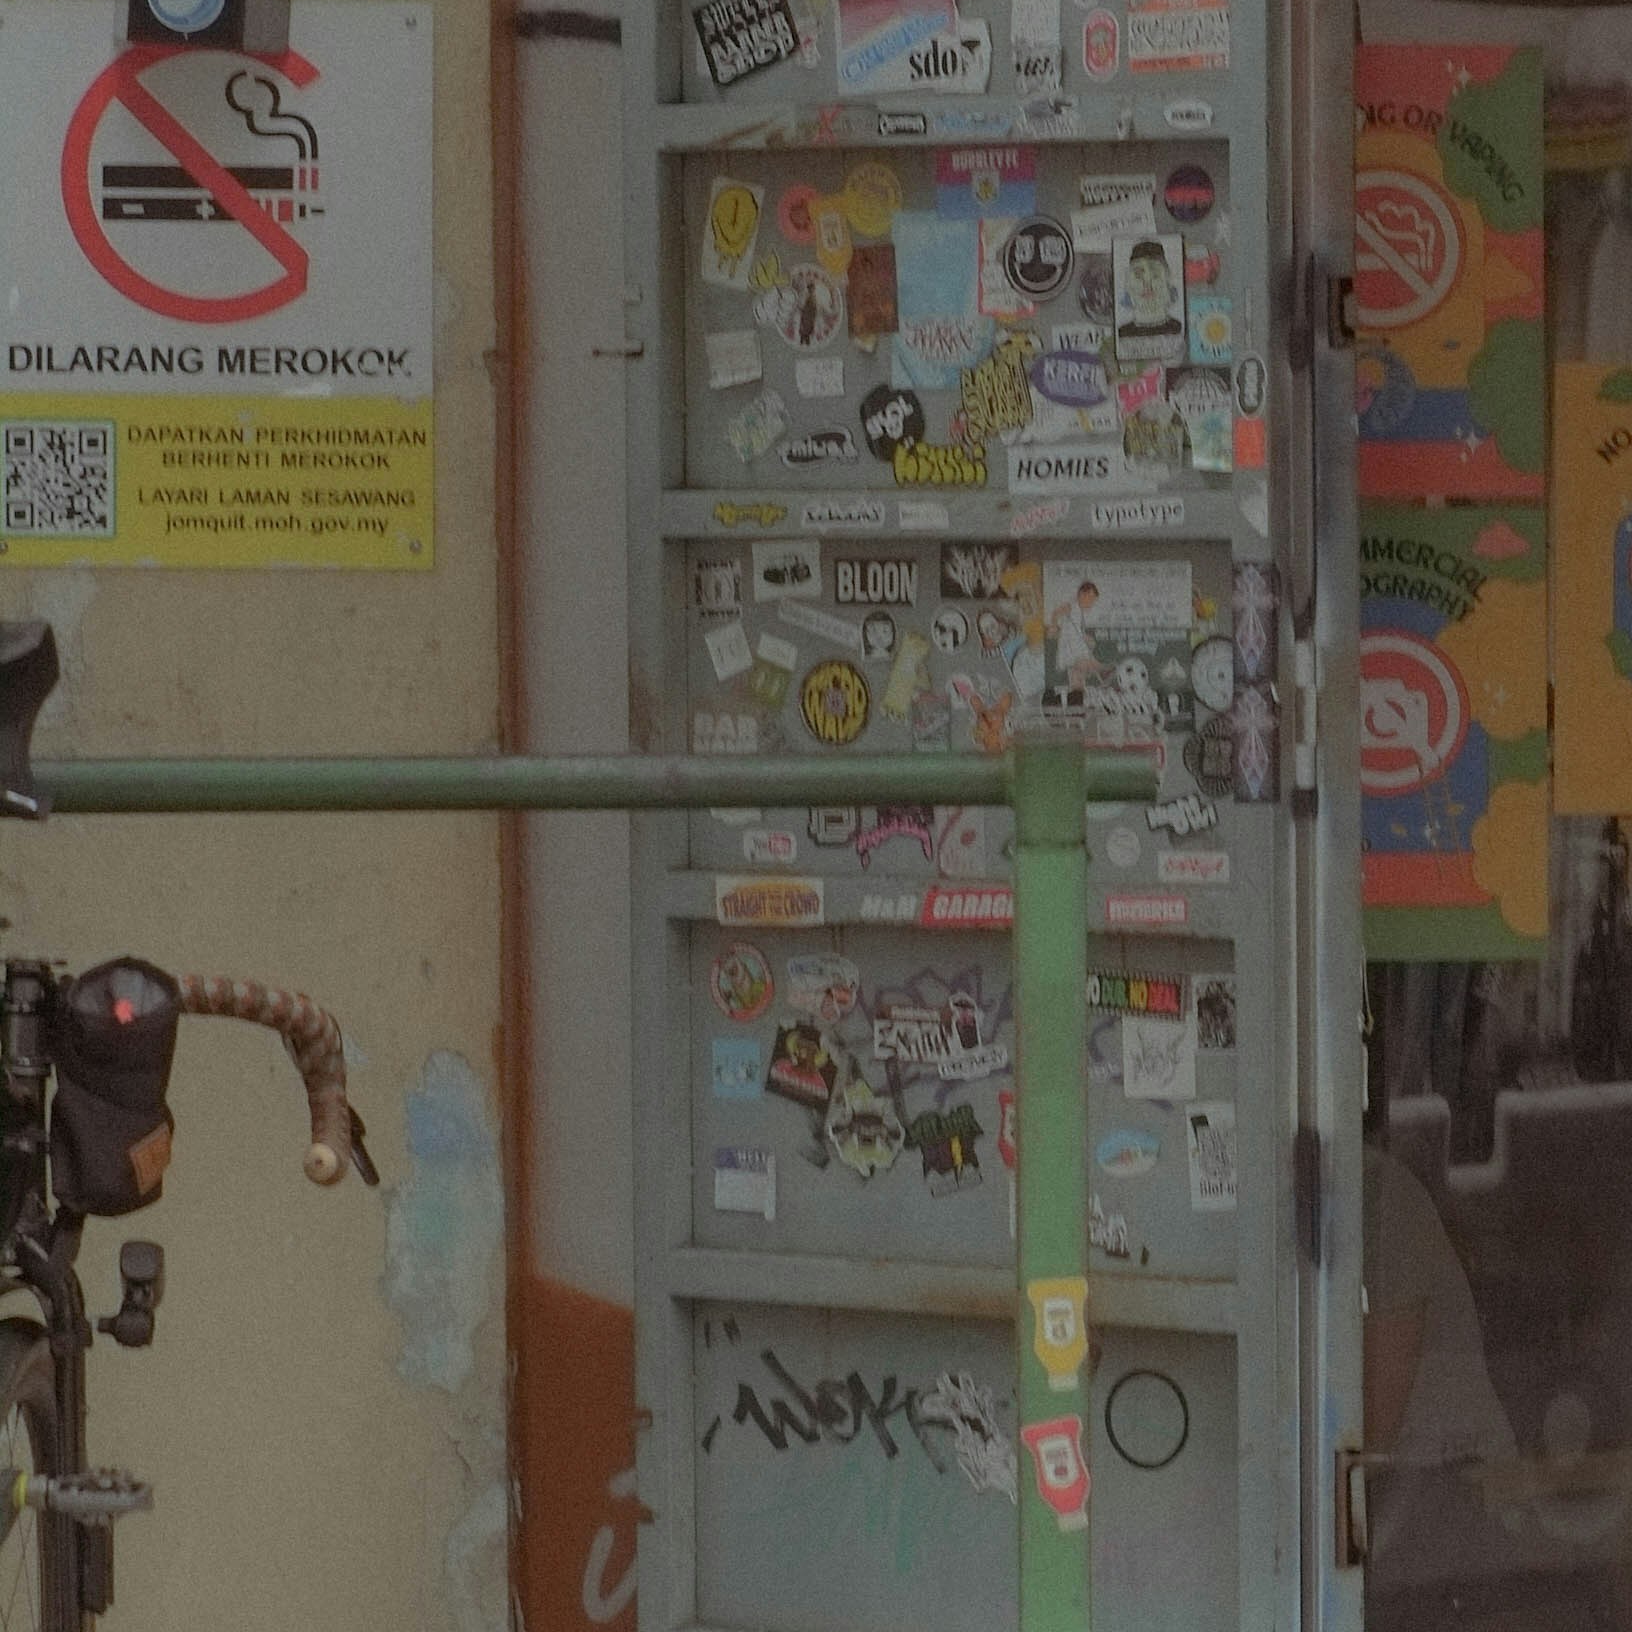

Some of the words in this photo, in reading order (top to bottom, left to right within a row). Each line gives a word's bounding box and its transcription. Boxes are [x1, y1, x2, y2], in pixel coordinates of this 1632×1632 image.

[8, 344, 204, 375] DILARANG
[217, 346, 411, 377] MEROKOK
[128, 424, 245, 445] DAPATKAN
[255, 425, 427, 447] PERKHIDMATAN
[1596, 428, 1632, 465] NO
[163, 451, 270, 469] BERHENTI
[281, 451, 391, 470] MEROKOK
[1017, 458, 1109, 480] HOMIES
[138, 488, 209, 506] LAYARI
[219, 489, 290, 506] LAMAN
[301, 489, 416, 508] SESAWANG
